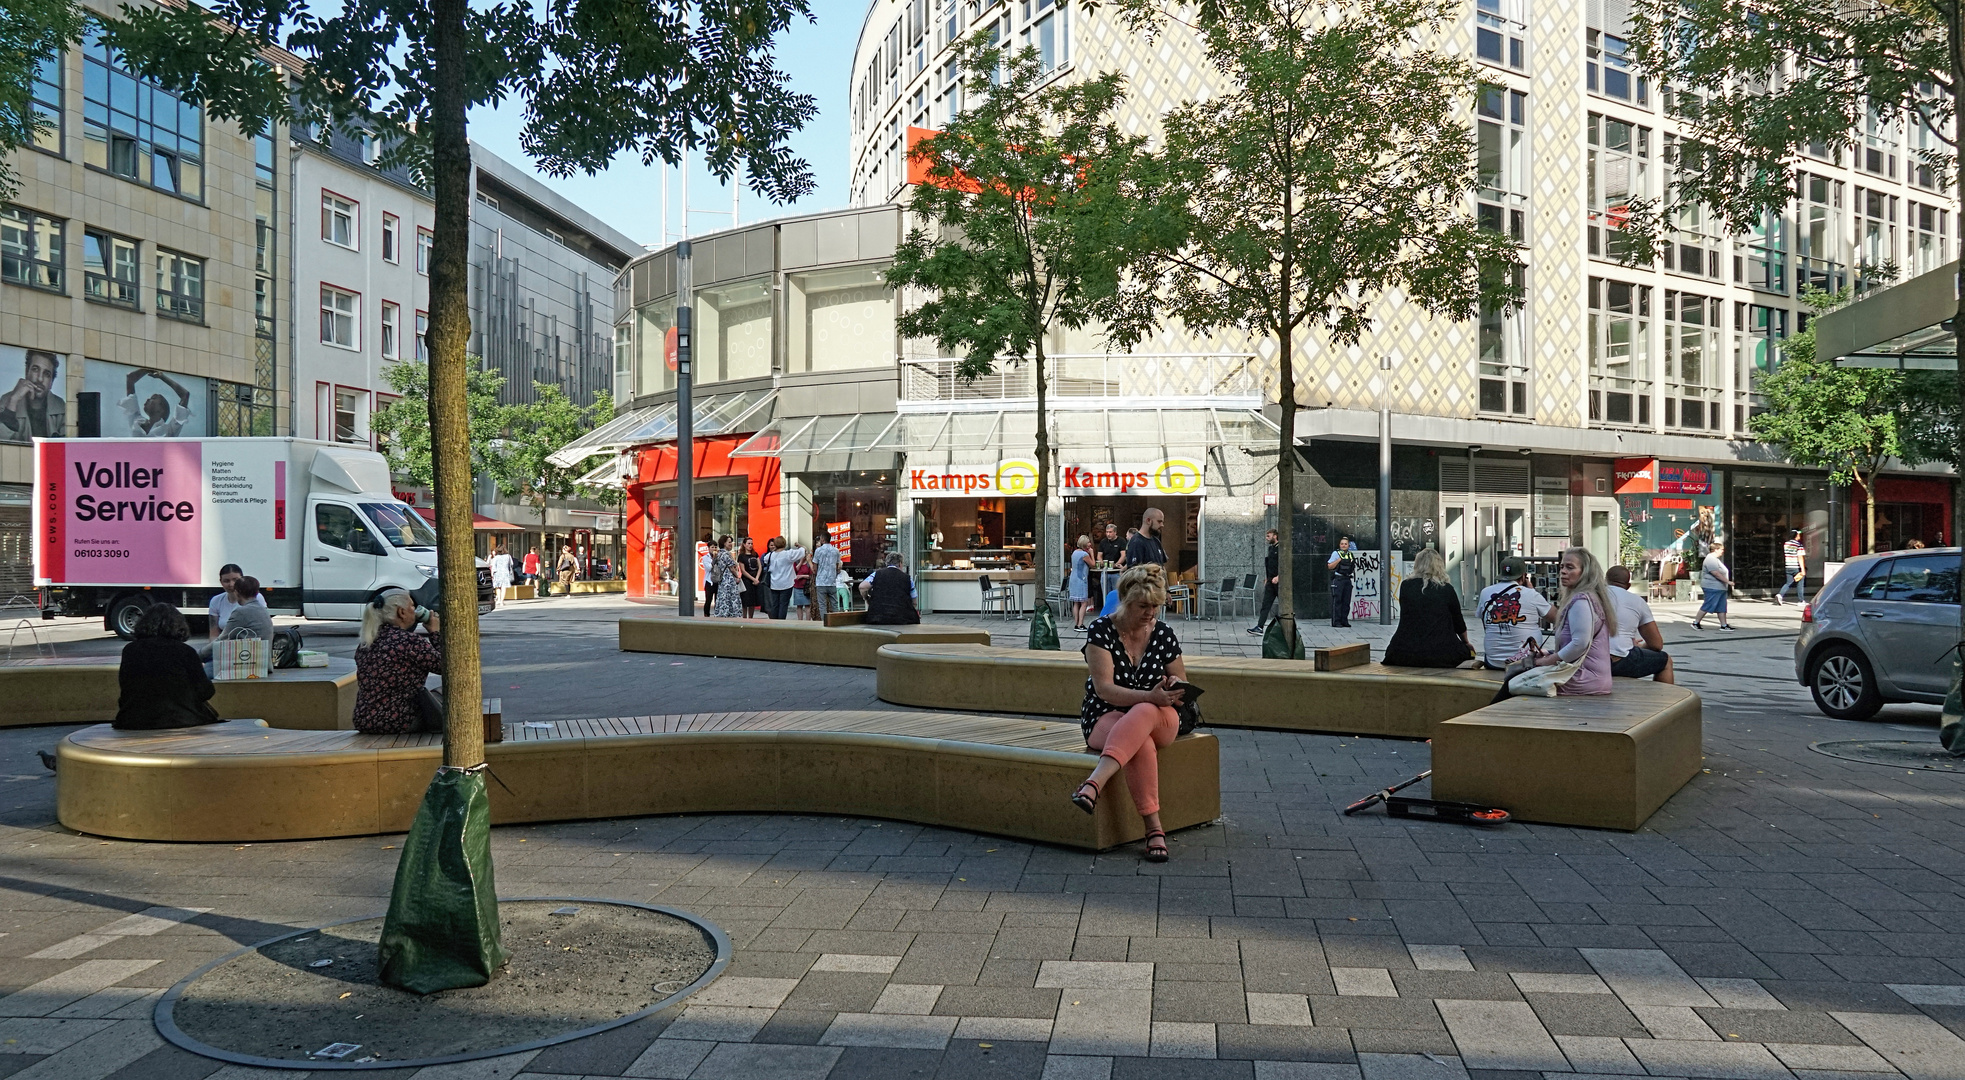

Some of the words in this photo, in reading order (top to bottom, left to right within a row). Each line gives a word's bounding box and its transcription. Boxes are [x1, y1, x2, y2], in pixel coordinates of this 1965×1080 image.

[74, 461, 164, 489] Voller
[911, 469, 990, 494] Kamps
[1064, 467, 1149, 493] Kamps
[1682, 468, 1707, 483] Nails
[49, 482, 57, 544] CWS.COM
[75, 494, 195, 522] Service
[840, 521, 851, 531] SALE
[840, 530, 851, 540] SALE
[840, 540, 851, 548] SALE
